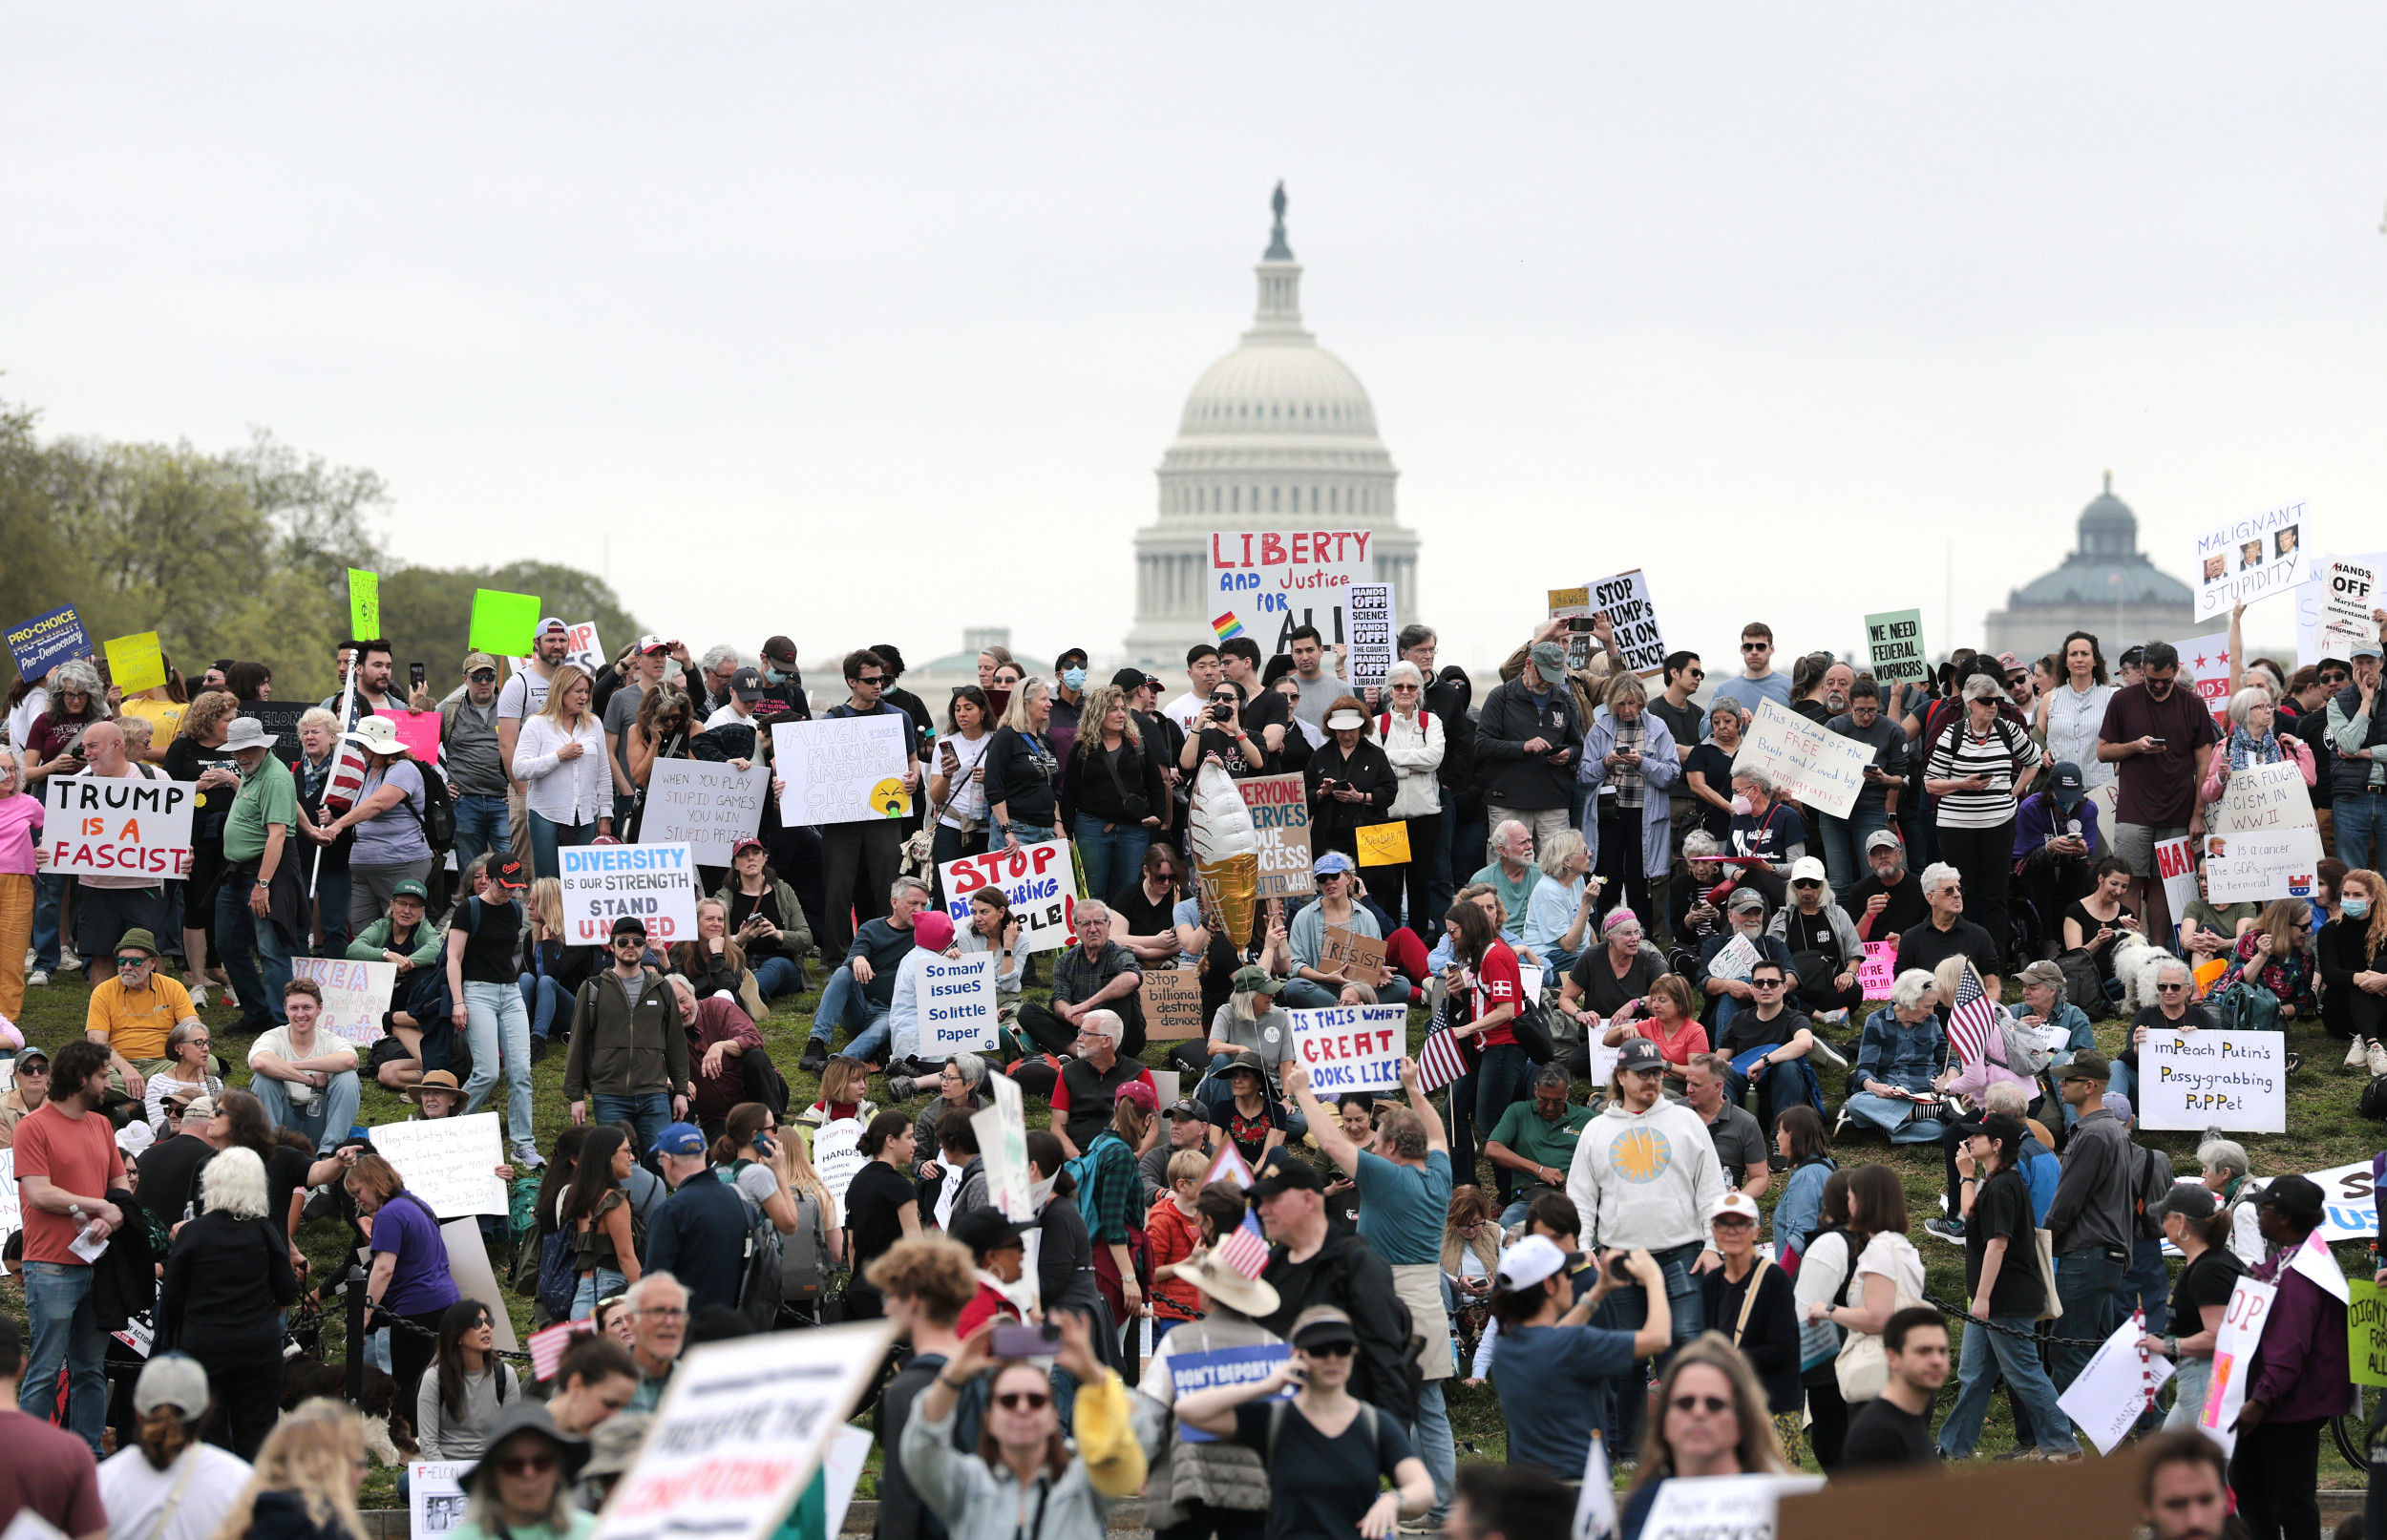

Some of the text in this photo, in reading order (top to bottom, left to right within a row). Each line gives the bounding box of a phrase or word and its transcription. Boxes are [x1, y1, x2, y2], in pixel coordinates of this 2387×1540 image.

[2198, 501, 2306, 556] MALIGNANT
[1213, 531, 1371, 569] LIBERTY
[1280, 568, 1350, 589] Justice
[2334, 562, 2372, 579] HANDS
[1354, 588, 1385, 597] HANDS
[1596, 579, 1633, 606] STOP
[2204, 554, 2298, 610] STUPIDITY
[2333, 577, 2370, 597] OFF
[1257, 593, 1289, 613] FOR
[1354, 596, 1386, 609] OFF!
[2327, 605, 2370, 621] understands
[2334, 597, 2367, 610] Maryland
[1352, 611, 1388, 621] SCIENCE
[8, 609, 77, 646] PRO-CHOICE
[1356, 631, 1387, 643] OFF!
[1636, 620, 1658, 643] ON
[1869, 621, 1917, 642] WE NEED
[21, 628, 83, 670] Pro-Democracy
[1356, 655, 1389, 664] HANDS
[1871, 641, 1918, 662] FEDERAL
[1873, 660, 1923, 682] WORKERS
[123, 675, 153, 689] POTUS
[784, 719, 866, 749] MAGA
[1763, 702, 1785, 725] This
[1790, 721, 1800, 730] is
[1801, 723, 1827, 743] Land
[1847, 746, 1864, 760] the
[808, 740, 890, 765] MAKING
[1784, 731, 1821, 757] FREE
[807, 755, 907, 784] AMERICANS
[1757, 737, 1857, 790] Built and Loved by
[663, 773, 753, 791] WHEN YOU PLAY
[1764, 755, 1844, 808] Immigrants
[2262, 765, 2301, 786] FOUGHT
[53, 781, 183, 814] TRUMP
[665, 791, 710, 806] STUPID
[804, 781, 860, 806] GAG
[2274, 789, 2287, 802] IN
[687, 810, 740, 823] YOU WIN
[803, 803, 870, 824] AGAIN
[81, 817, 139, 843] IS A
[665, 826, 709, 843] STUPID
[1361, 830, 1407, 846] SOLIDARITY
[53, 841, 187, 874] FASCIST
[564, 848, 686, 872] DIVERSITY
[2237, 844, 2257, 855] is a
[950, 847, 1056, 894] STOP
[2207, 864, 2228, 876] The
[2263, 861, 2305, 876] prognosis
[564, 873, 689, 891] IS OUR STRENGTH
[1285, 871, 1312, 893] WHAT
[2213, 875, 2271, 891] is terminal
[590, 897, 658, 917] STAND
[1329, 942, 1384, 969] RESIST
[926, 965, 945, 978] So
[1146, 972, 1179, 988] Stop
[929, 1003, 986, 1021] So little
[1293, 1009, 1405, 1031] IS THIS WHAT
[1303, 1030, 1393, 1063] GREAT
[2222, 1042, 2271, 1059] Putin's
[2161, 1065, 2272, 1093] Pussy-grabbing
[373, 1128, 413, 1149] They're
[416, 1129, 443, 1142] Eating
[444, 1128, 458, 1137] the
[822, 1130, 839, 1143] STOP
[414, 1150, 442, 1161] Eating
[822, 1149, 859, 1163] HANDS
[822, 1162, 851, 1172] Science
[420, 1181, 439, 1193] Hey
[1174, 1361, 1268, 1387] DON'T DEPORT
